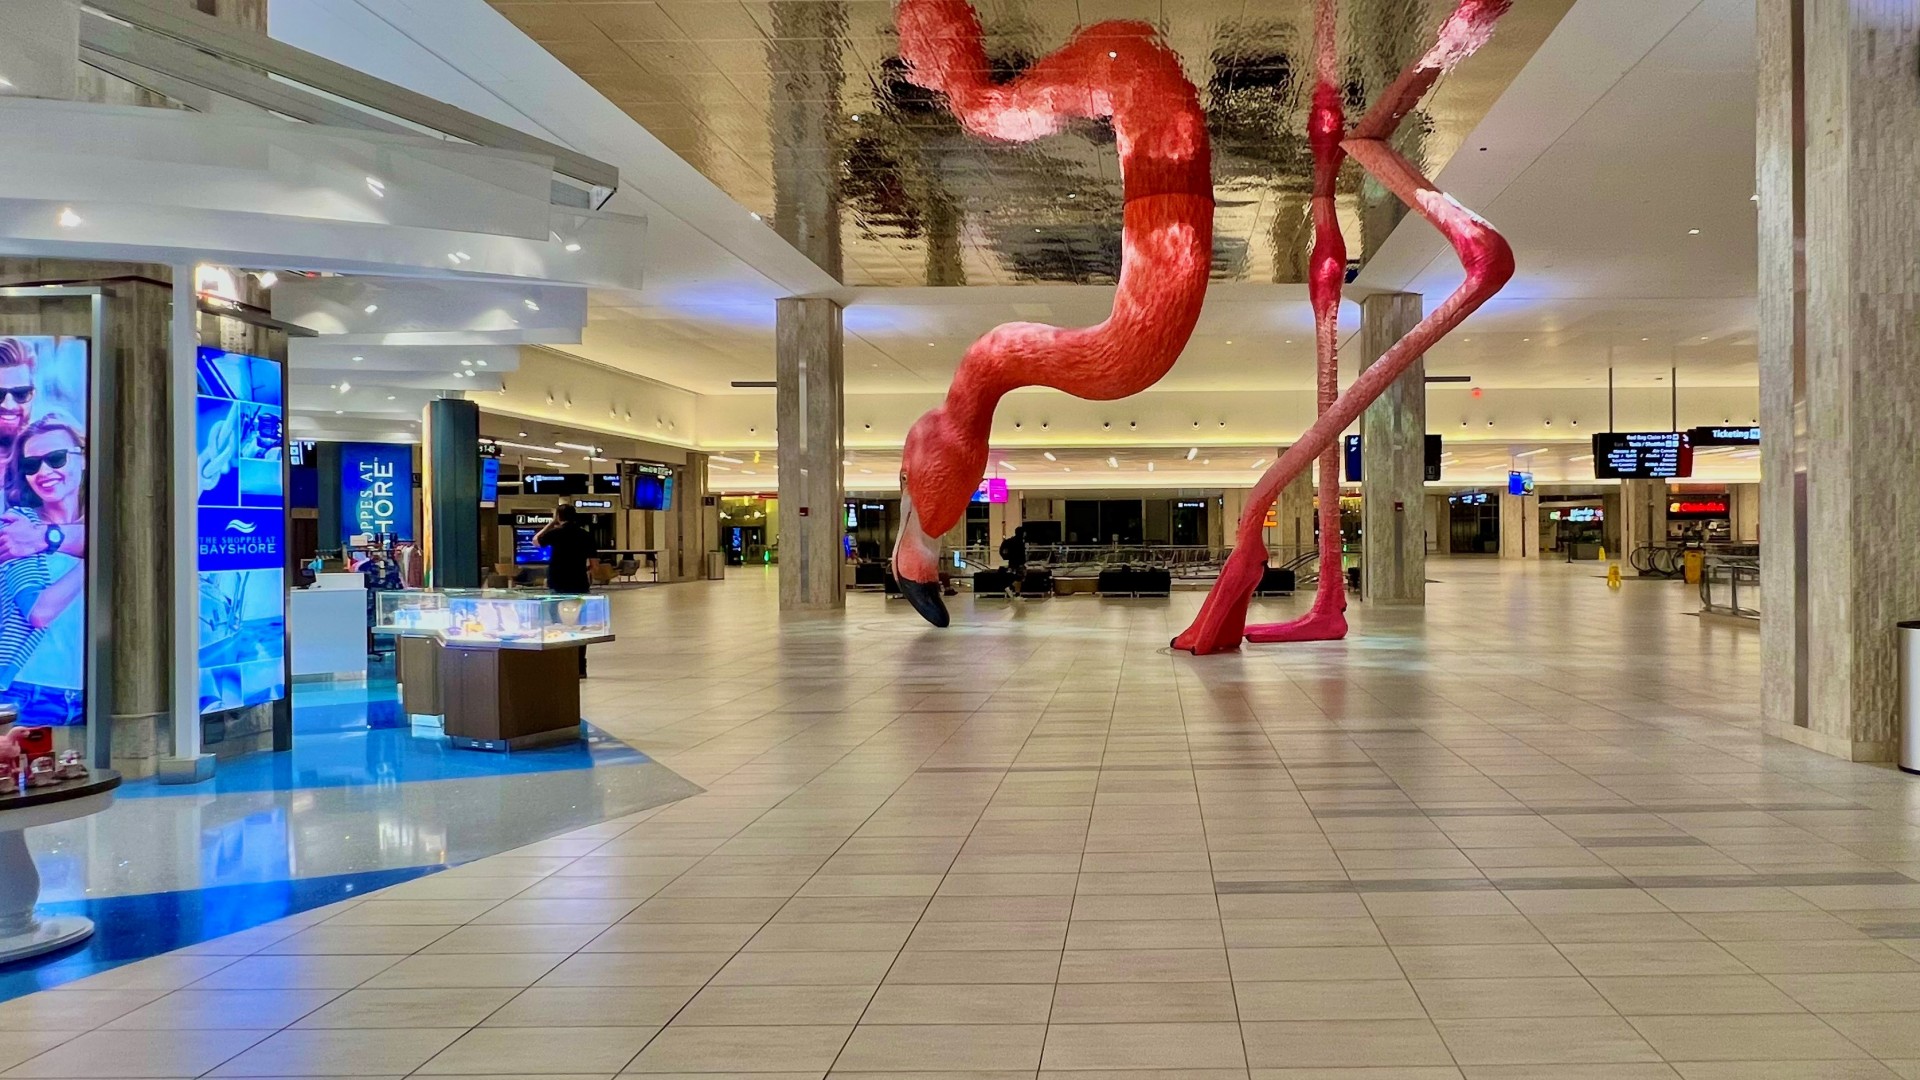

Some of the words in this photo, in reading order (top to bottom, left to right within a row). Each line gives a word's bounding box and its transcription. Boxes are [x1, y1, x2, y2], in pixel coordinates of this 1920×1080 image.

[1712, 429, 1749, 439] Ticketing
[360, 462, 373, 482] AT
[200, 543, 276, 555] BAYSHORE
